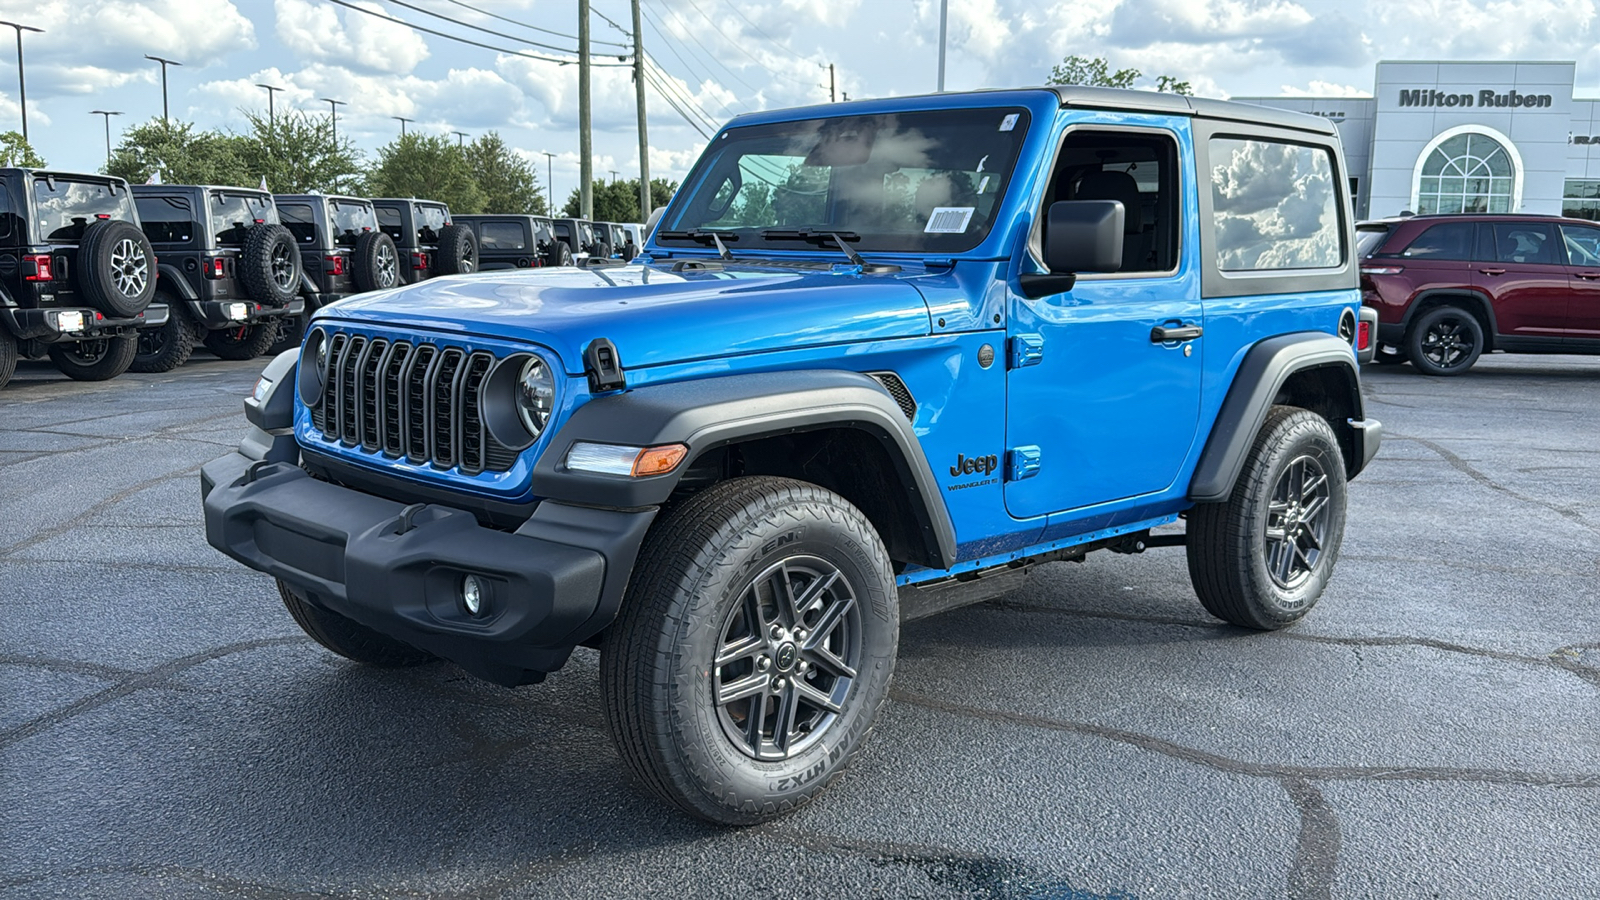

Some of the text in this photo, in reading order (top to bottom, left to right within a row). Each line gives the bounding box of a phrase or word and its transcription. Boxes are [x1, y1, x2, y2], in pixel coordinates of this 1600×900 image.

[1399, 89, 1552, 108] Milton Ruben
[950, 453, 998, 477] Jeep
[947, 480, 990, 491] WRANGLER
[715, 532, 794, 613] NEXEN
[844, 540, 876, 579] All-Weather
[777, 760, 826, 792] HTX2
